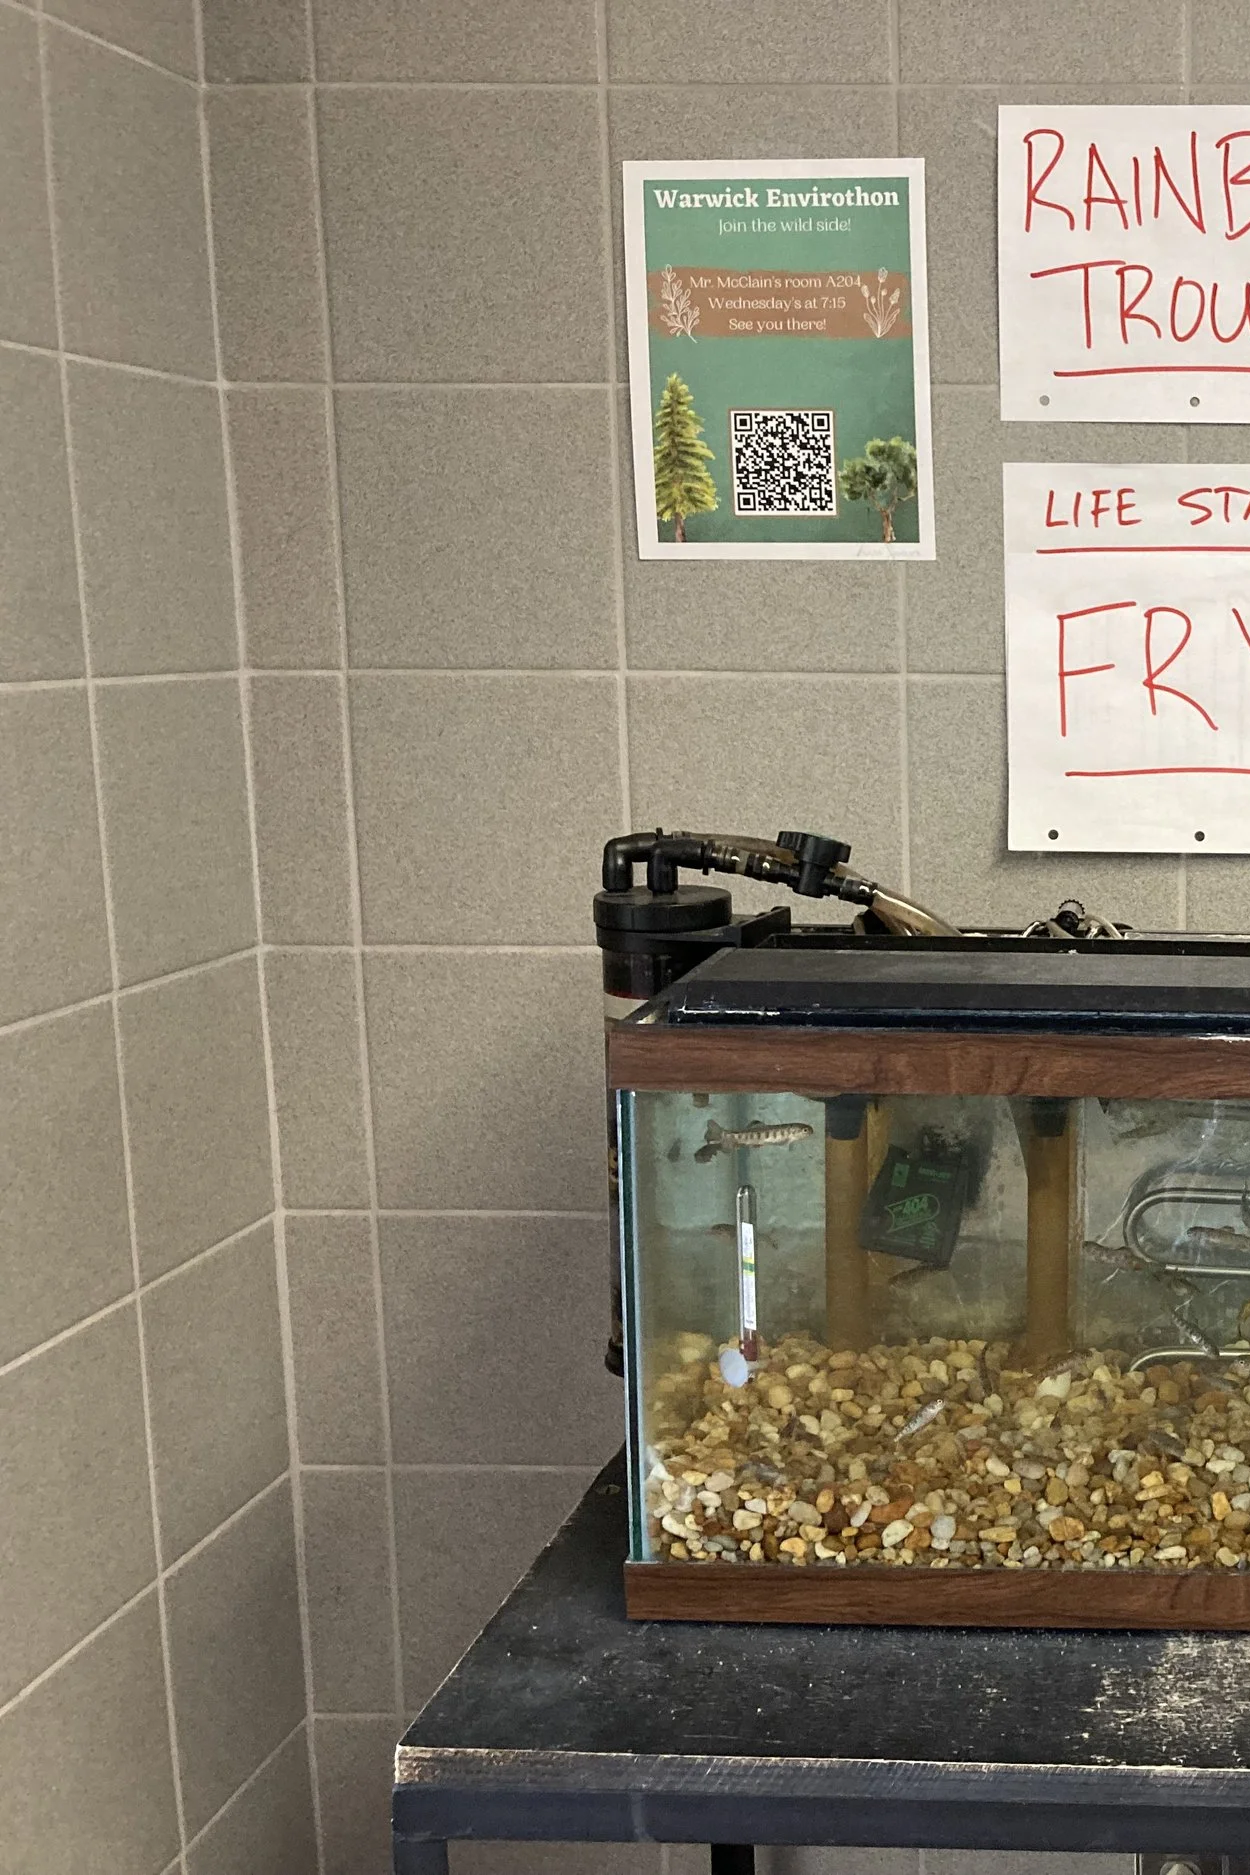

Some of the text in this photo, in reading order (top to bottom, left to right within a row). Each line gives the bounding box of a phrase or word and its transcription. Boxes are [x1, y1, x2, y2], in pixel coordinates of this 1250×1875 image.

[653, 186, 900, 208] Warwick Envirothon
[719, 218, 851, 235] Join the wild side!
[690, 275, 861, 289] Mr. McClain's room A204
[708, 297, 846, 312] Wednesday's at 7:15
[729, 317, 827, 332] See you there!
[1045, 488, 1142, 528] LIFE
